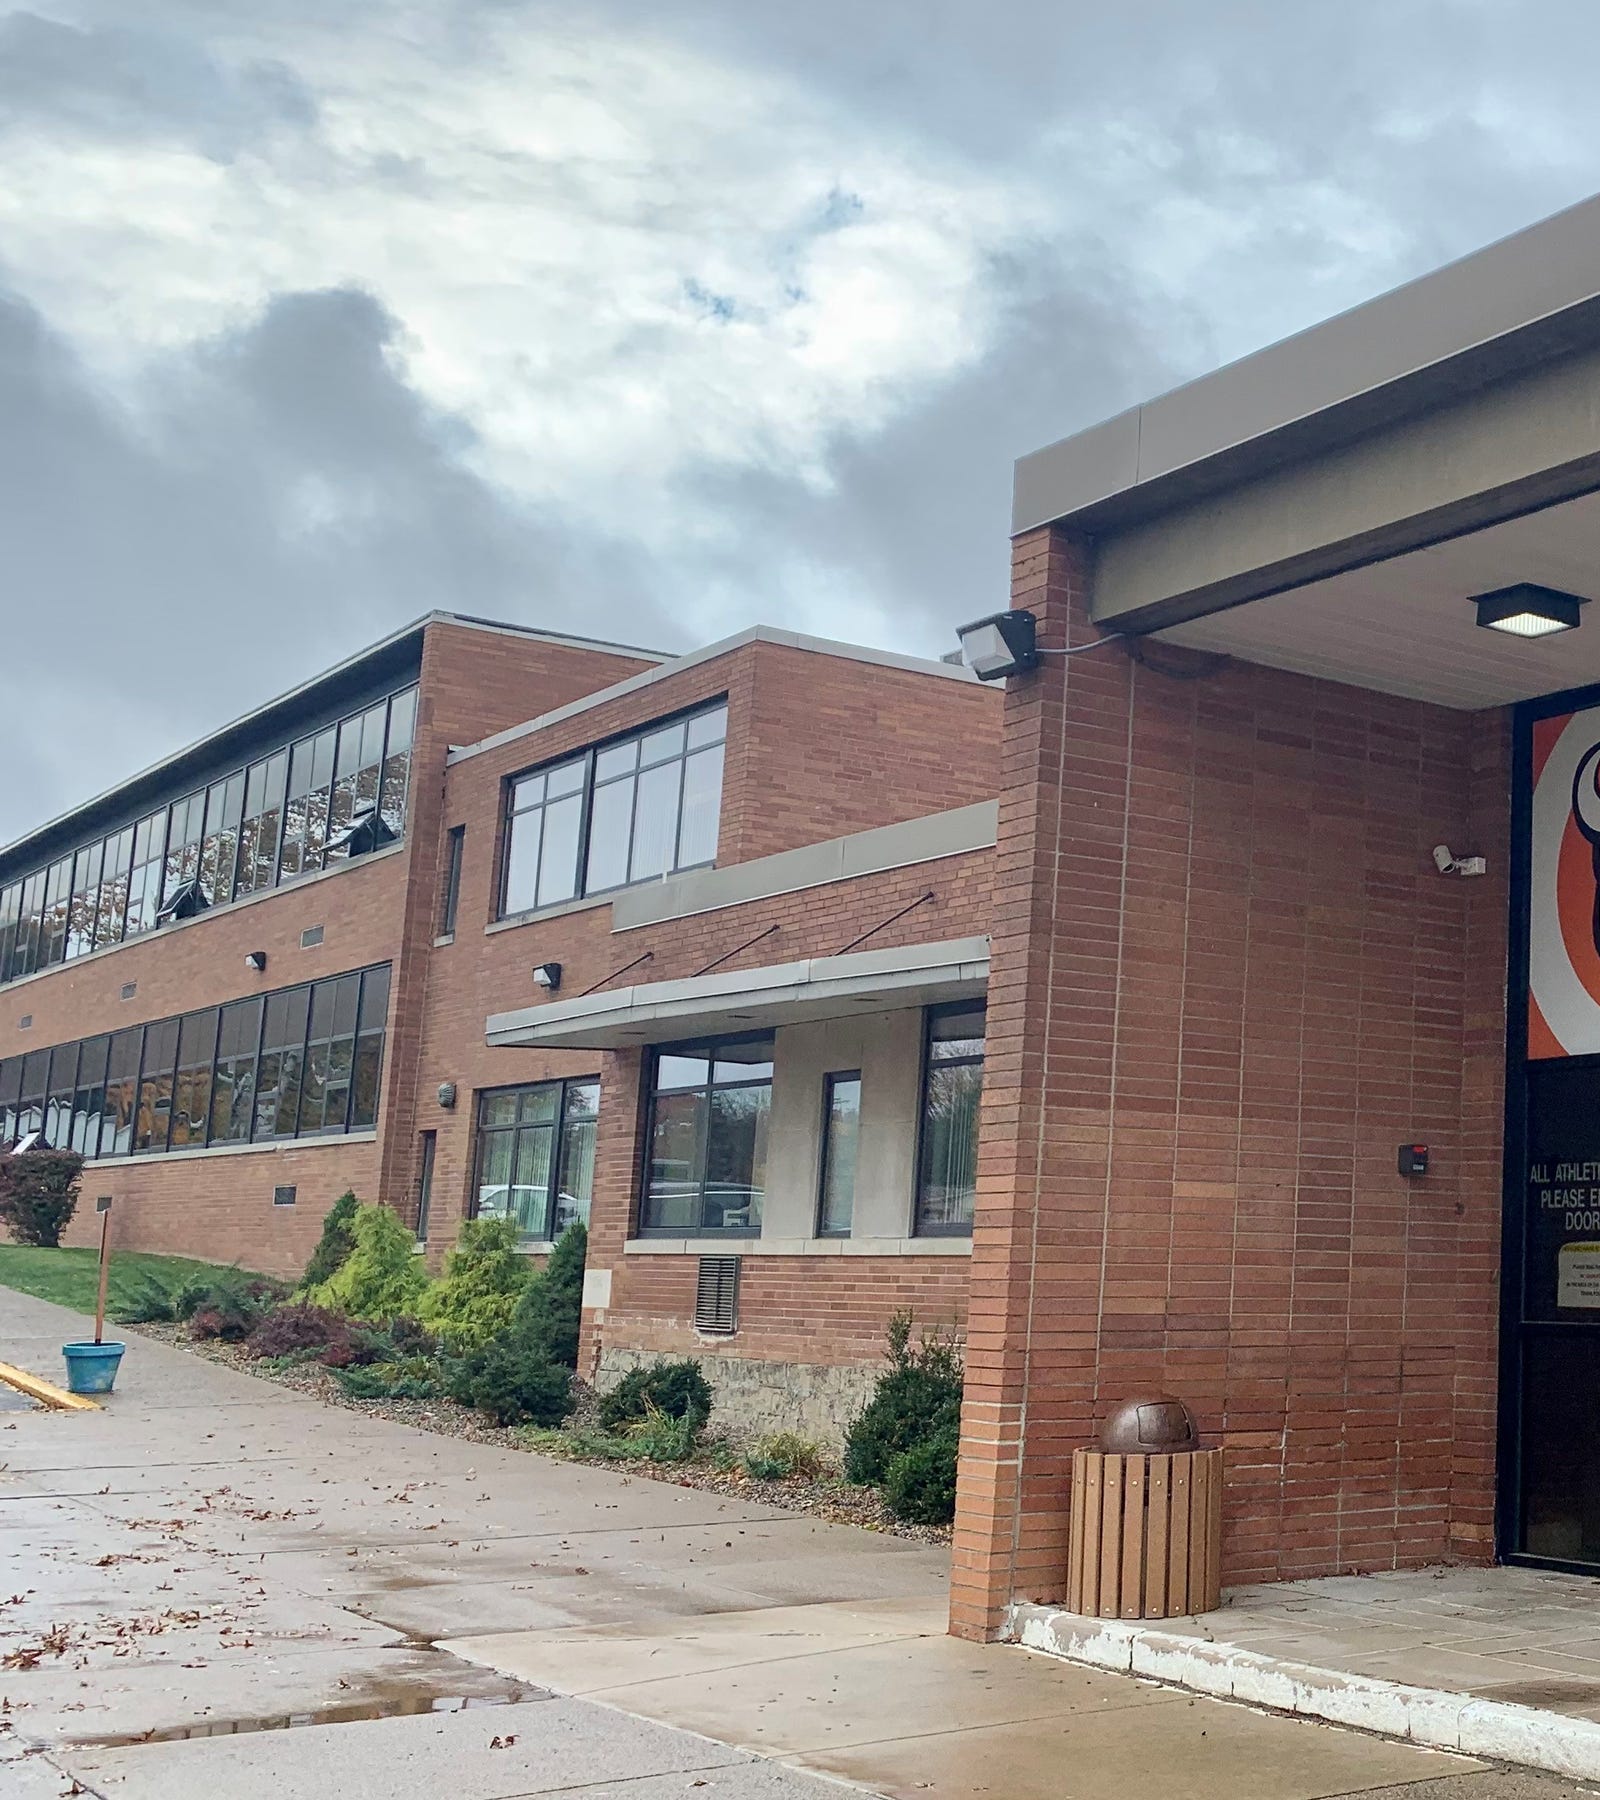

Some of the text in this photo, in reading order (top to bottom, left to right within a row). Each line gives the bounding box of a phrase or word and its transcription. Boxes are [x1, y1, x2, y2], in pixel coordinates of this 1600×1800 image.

[1530, 1163, 1551, 1183] ALL
[1541, 1188, 1586, 1209] PLEASE
[1565, 1210, 1600, 1231] DOOR
